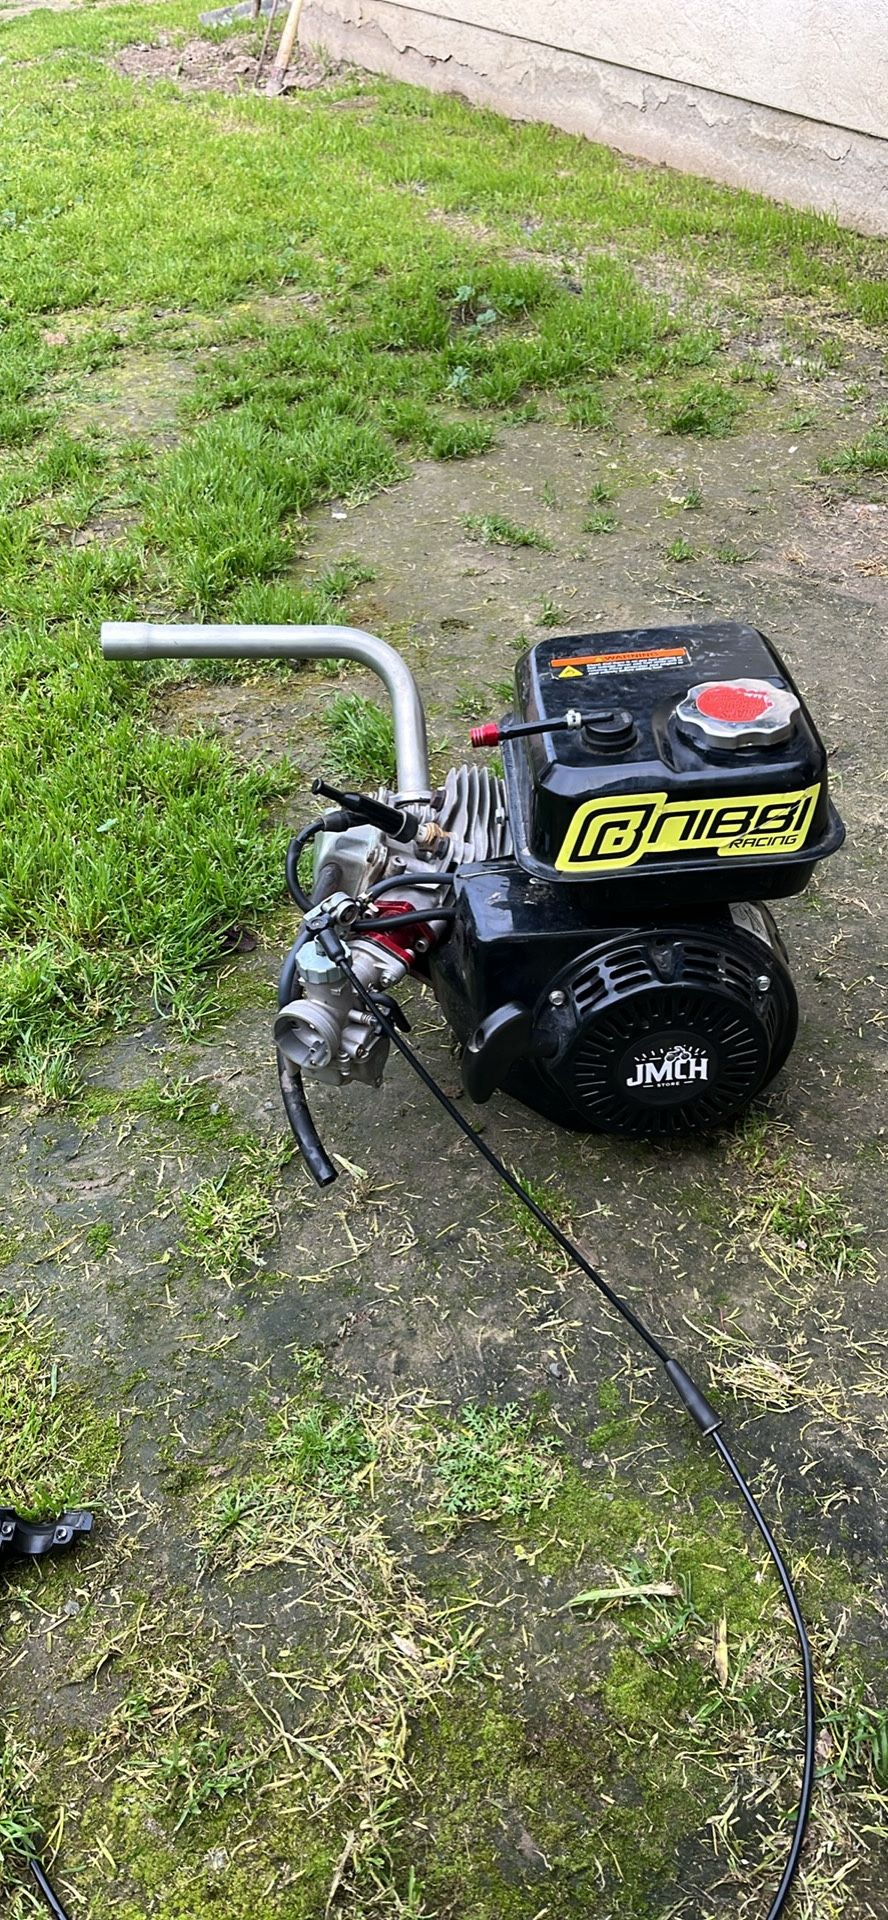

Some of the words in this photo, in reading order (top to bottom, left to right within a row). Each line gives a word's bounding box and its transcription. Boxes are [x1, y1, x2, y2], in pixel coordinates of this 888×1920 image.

[604, 651, 660, 661] WARNING
[729, 834, 798, 849] RACING
[626, 1058, 709, 1087] JMCH
